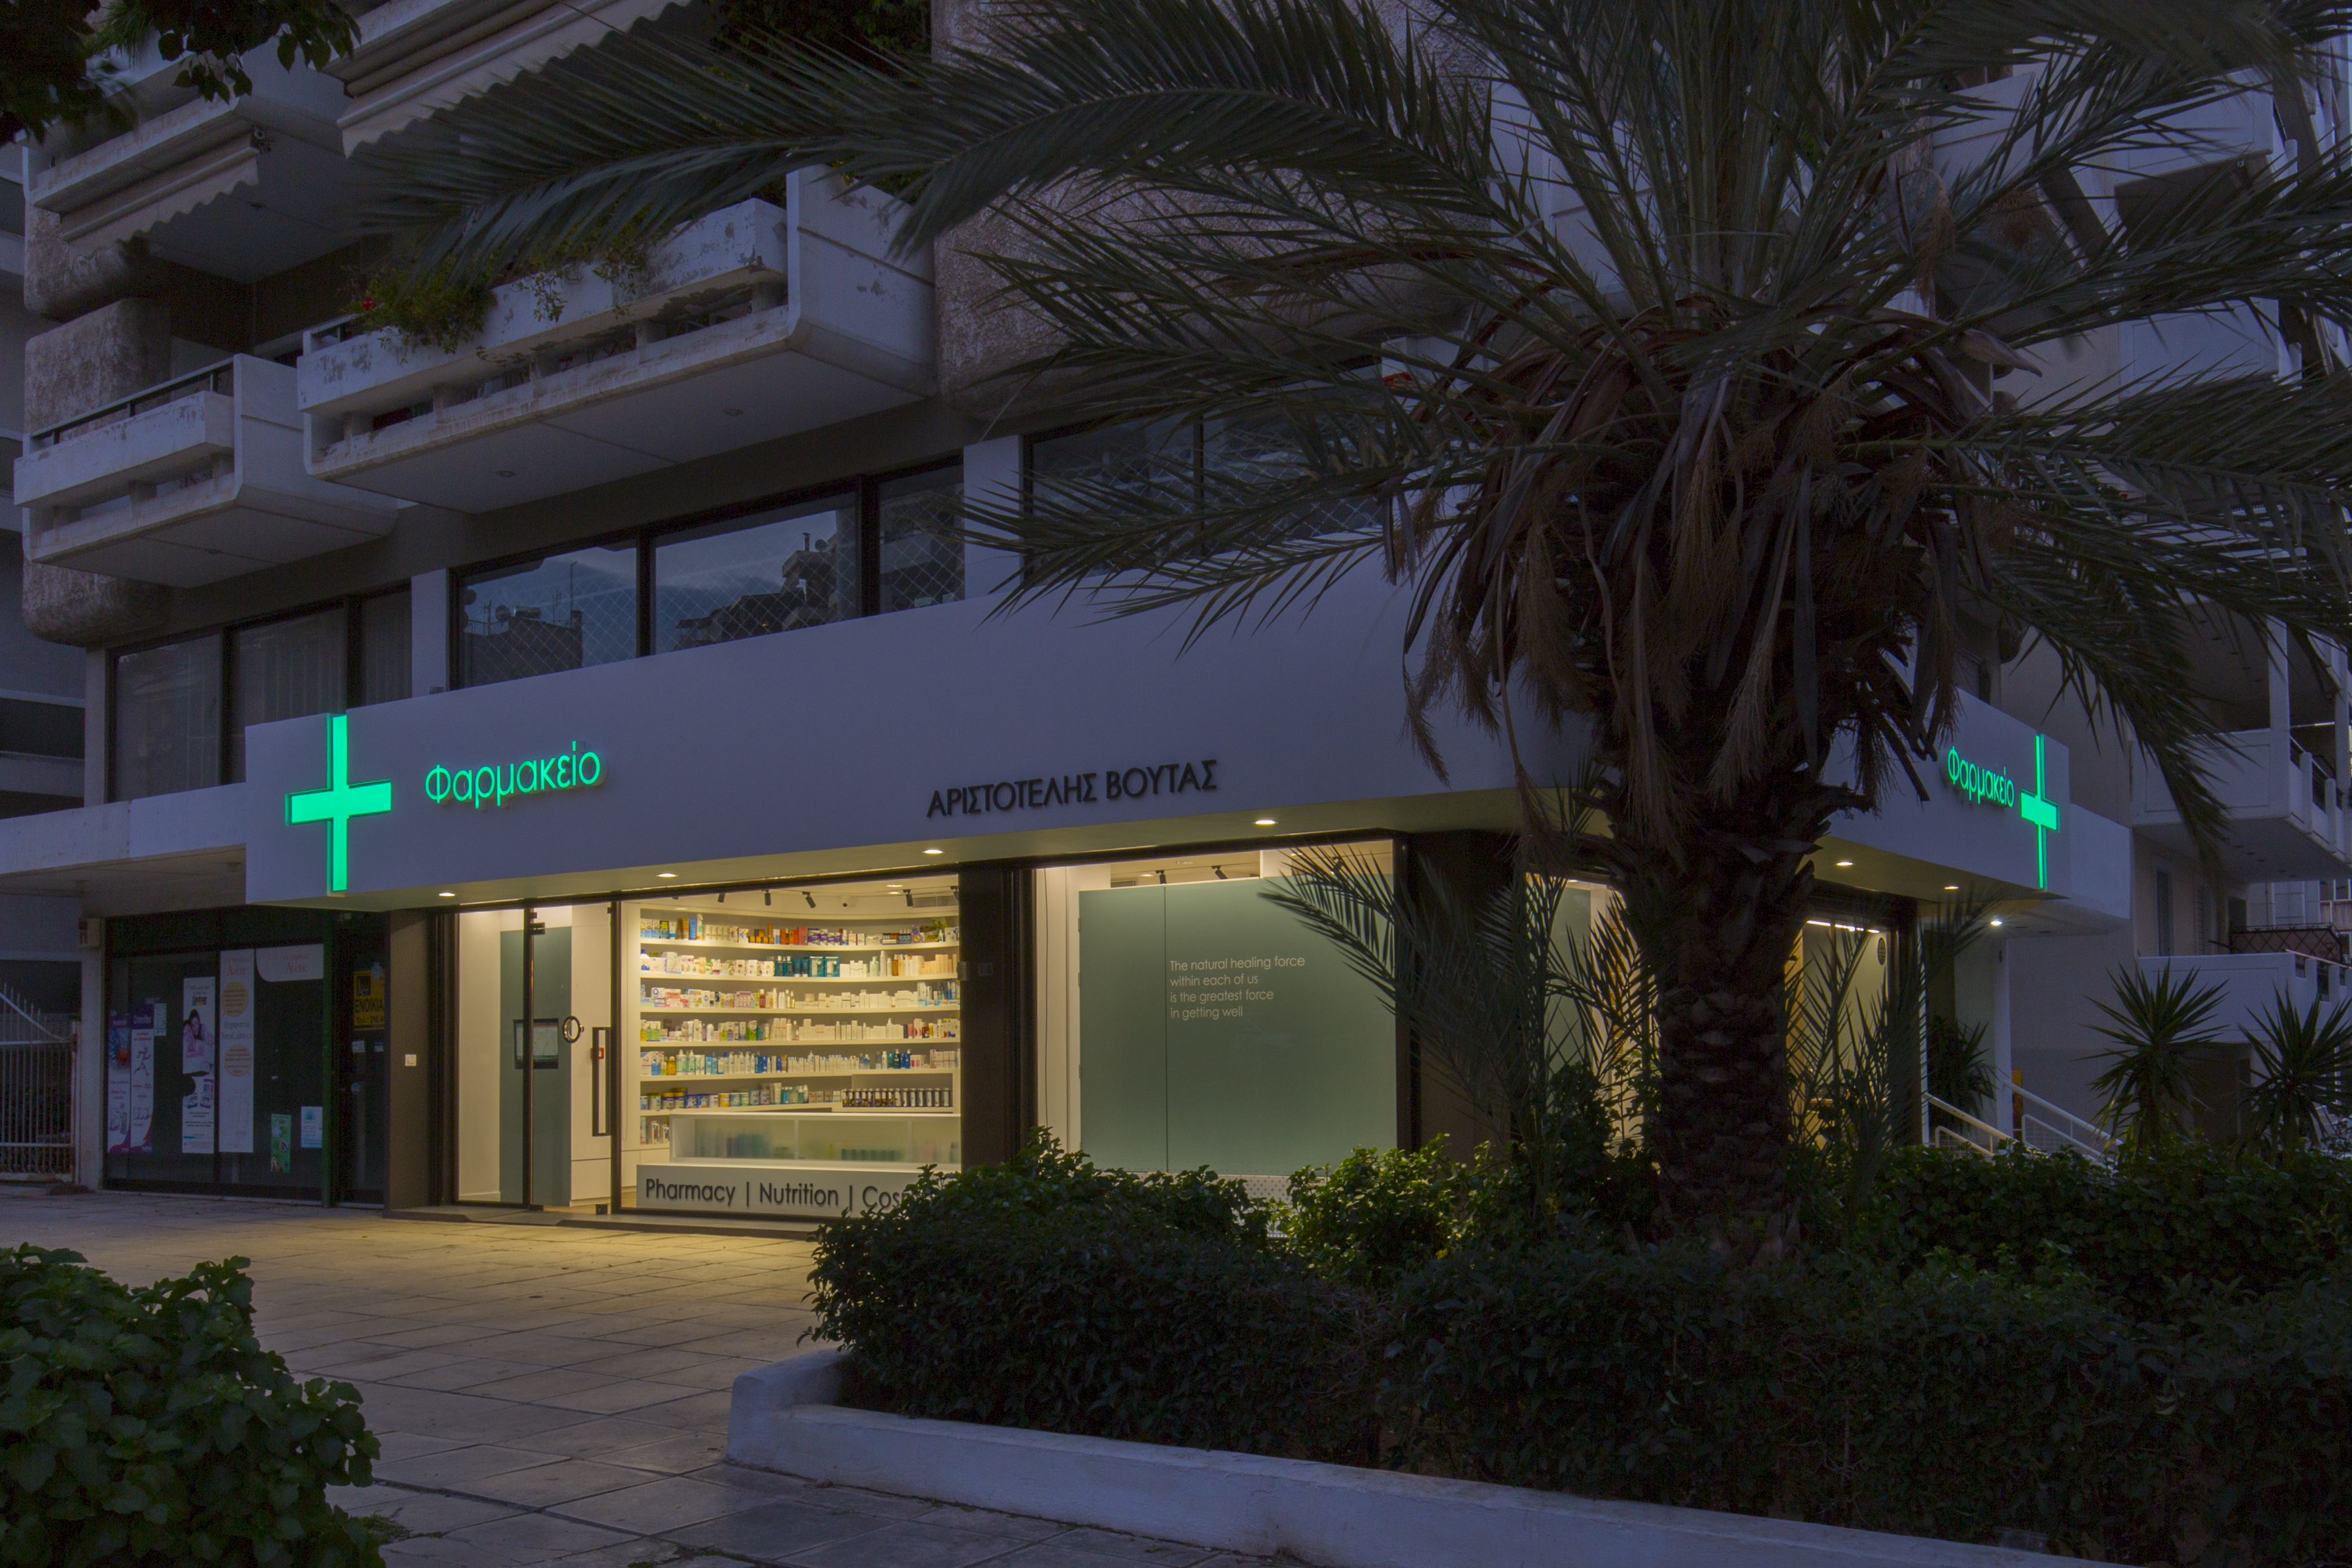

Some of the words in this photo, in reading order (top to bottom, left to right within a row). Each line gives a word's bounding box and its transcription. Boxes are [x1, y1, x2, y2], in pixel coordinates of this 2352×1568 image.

[424, 740, 602, 809] Φαρμακείο
[1947, 745, 2015, 807] Φαρμακείο
[926, 772, 1098, 818] ΑΡΙΣΤΟΤΕΛΗΣ
[1105, 759, 1217, 799] ΒΟΥΤΑΣ
[1170, 960, 1188, 971] The
[1190, 959, 1227, 970] natural
[1230, 956, 1271, 970] healing
[1274, 955, 1305, 967] force
[1170, 974, 1200, 986] within
[1203, 974, 1231, 986] each
[1234, 973, 1245, 985] of
[1247, 975, 1258, 984] us
[1170, 991, 1177, 1003] is
[1179, 991, 1197, 1002] the
[1199, 990, 1243, 1004] greatest
[1245, 989, 1274, 1000] force
[1170, 1007, 1179, 1018] in
[1182, 1007, 1219, 1021] getting
[1222, 1005, 1243, 1016] well
[646, 1178, 735, 1206] Pharmacy
[760, 1183, 839, 1206] Nutrition
